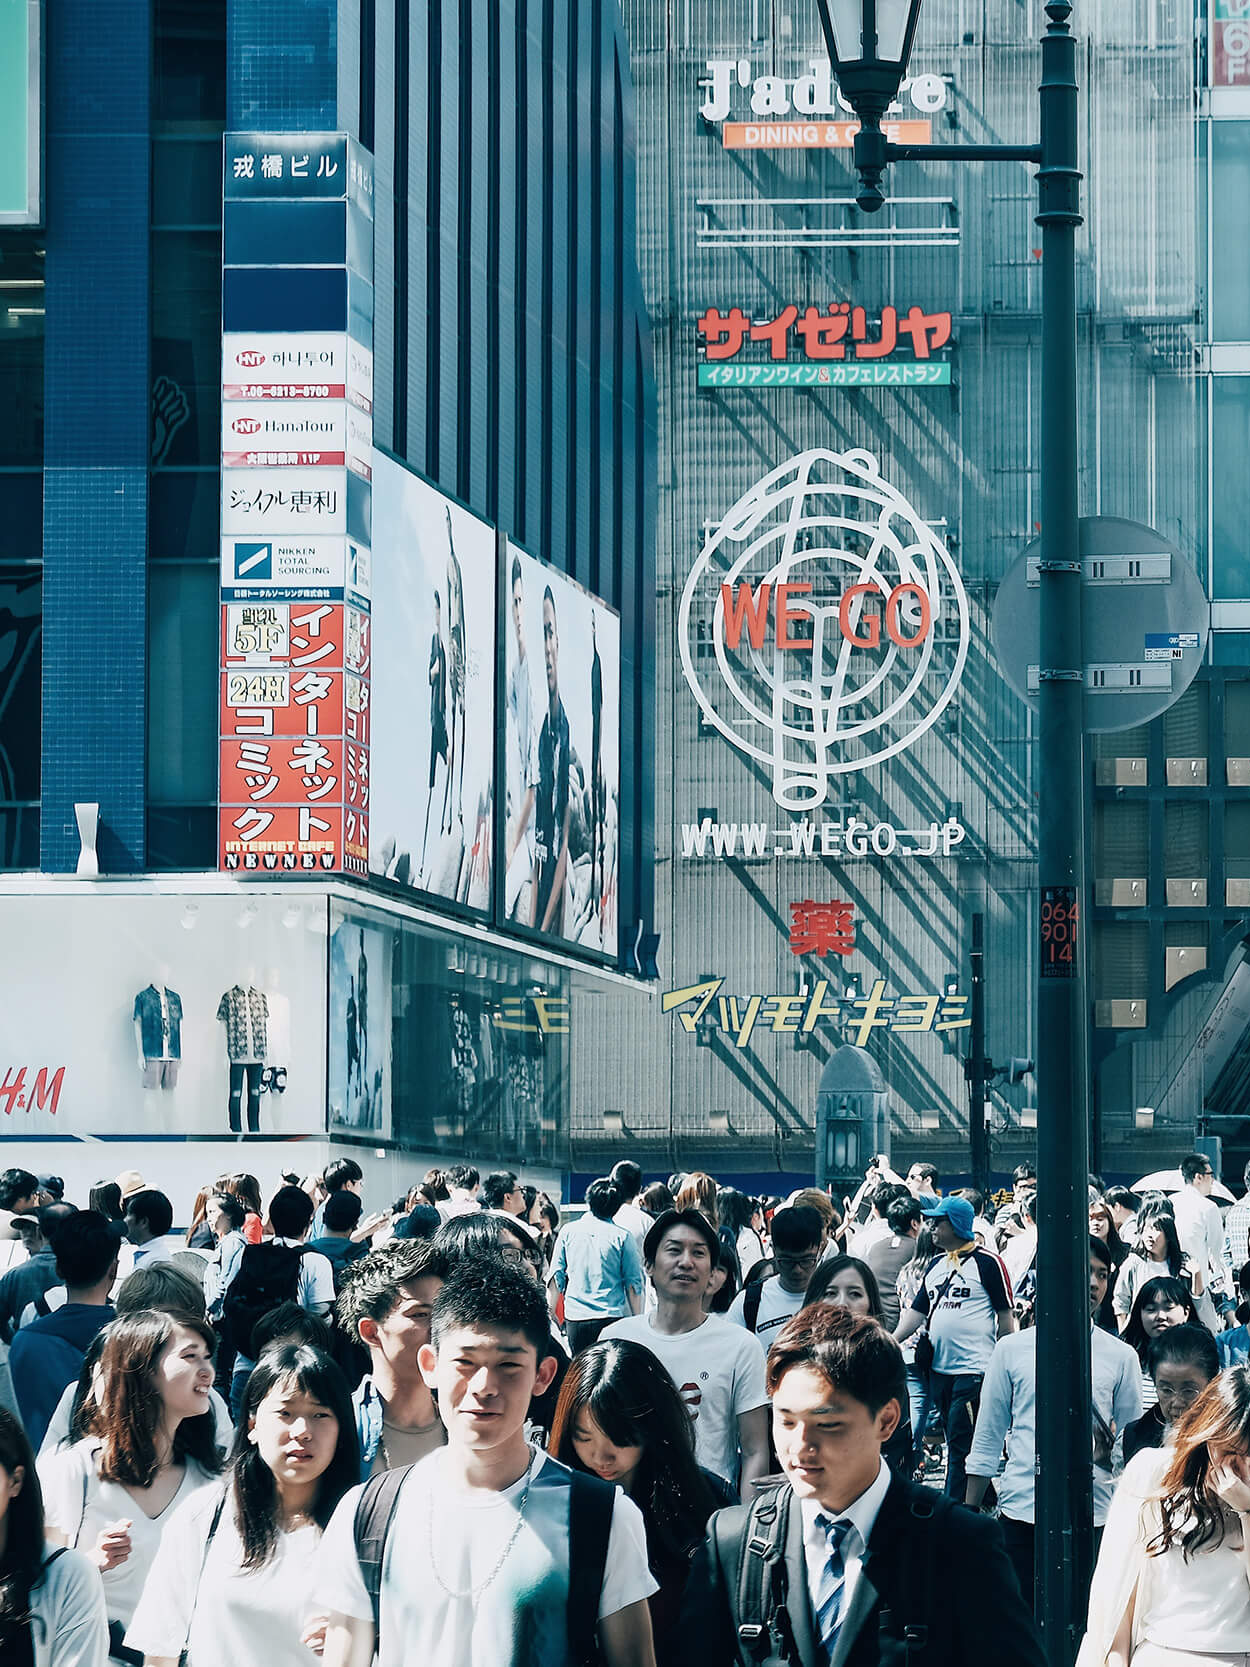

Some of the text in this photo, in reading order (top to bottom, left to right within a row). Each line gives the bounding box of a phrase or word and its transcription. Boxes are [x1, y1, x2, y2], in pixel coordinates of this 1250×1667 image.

[699, 59, 947, 121] J'ade
[745, 125, 901, 144] DINING & CE
[233, 154, 338, 179] 戎橋ビル
[698, 302, 951, 359] サイゼリヤ
[230, 489, 337, 514] ジョイフル恵利
[278, 557, 309, 565] TOTAL
[278, 567, 331, 575] SOURCING
[721, 583, 931, 650] WE GO
[234, 624, 285, 653] 5F
[231, 676, 285, 702] 24H
[288, 604, 337, 841] インターネット
[232, 708, 280, 841] コミック
[225, 841, 296, 852] INTERNET
[298, 841, 335, 852] CAFE
[681, 822, 965, 857] WWW.WEGO.JP
[1041, 902, 1079, 921] 064
[789, 899, 855, 958] 薬
[1041, 923, 1076, 942] 901
[1050, 943, 1072, 962] 14
[662, 977, 972, 1047] マツモトキヨシ
[0, 1066, 66, 1115] H&M
[952, 1287, 971, 1298] 28
